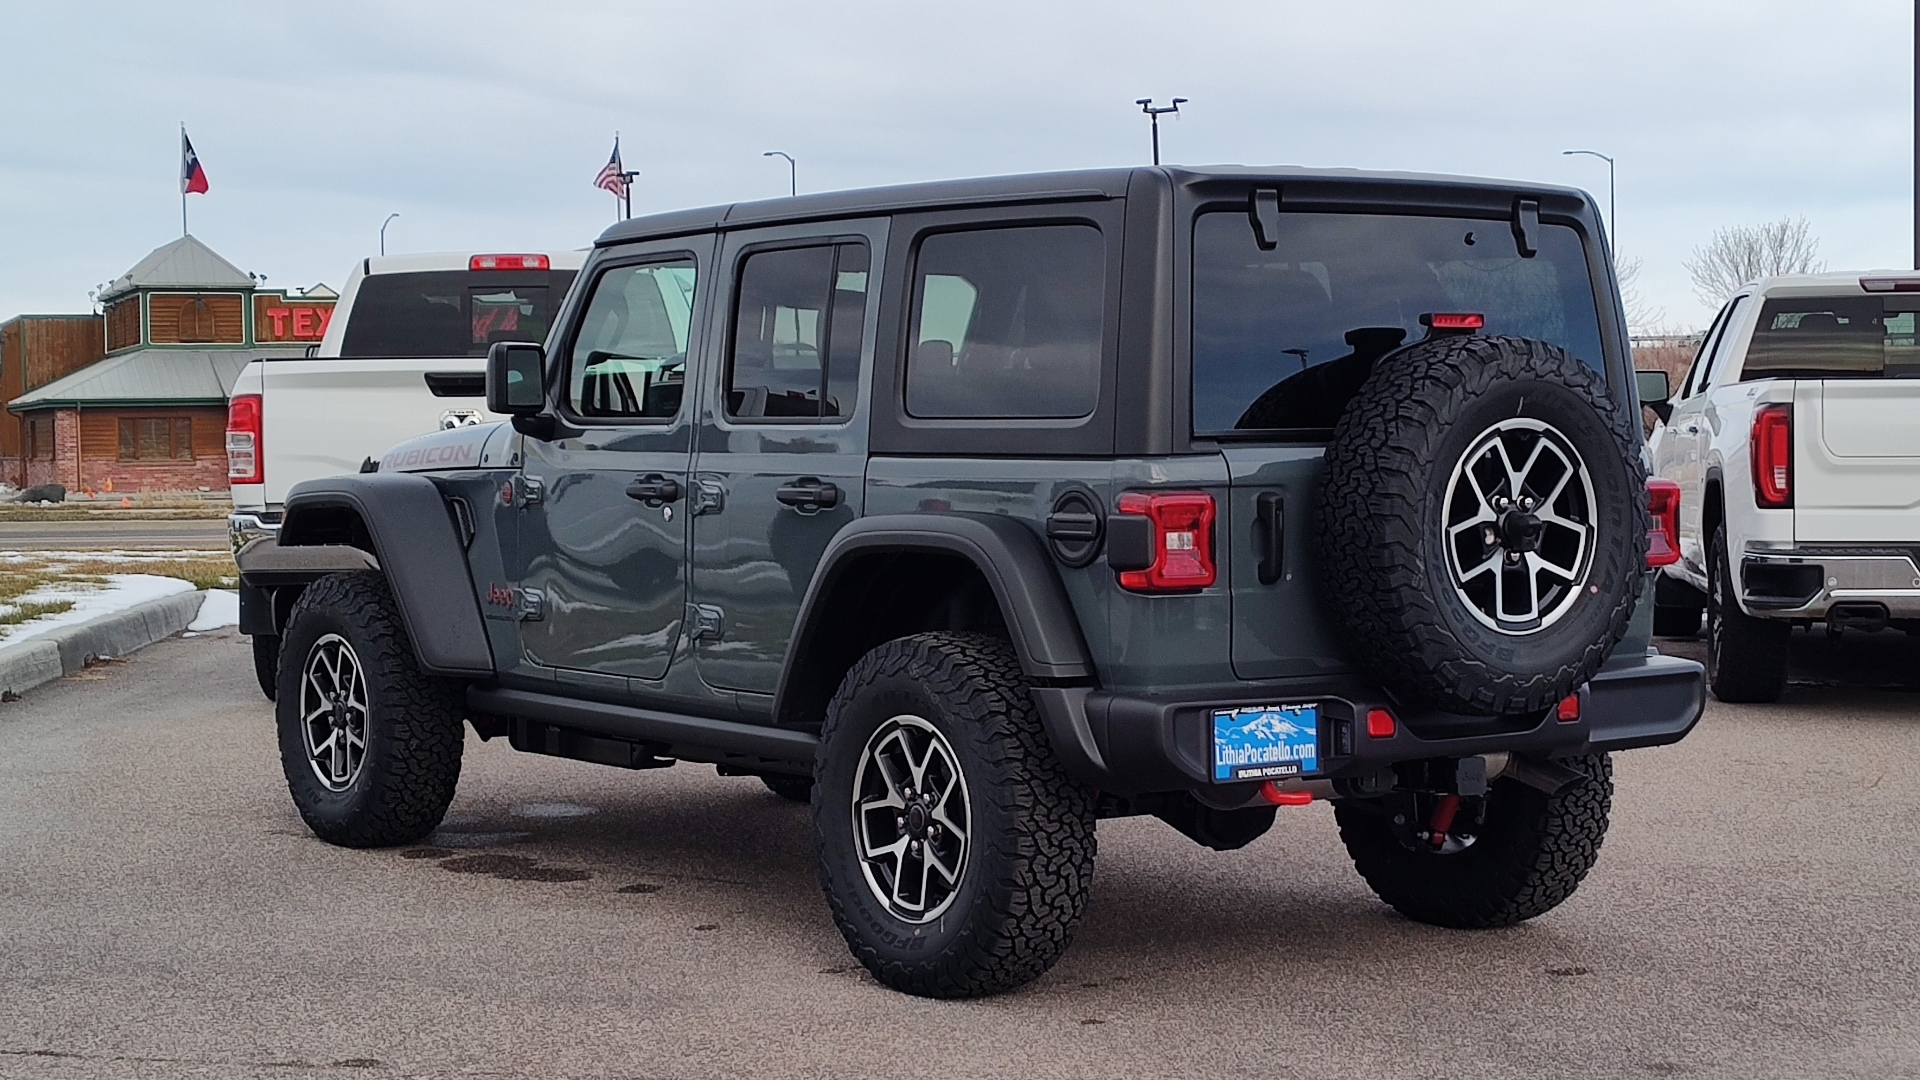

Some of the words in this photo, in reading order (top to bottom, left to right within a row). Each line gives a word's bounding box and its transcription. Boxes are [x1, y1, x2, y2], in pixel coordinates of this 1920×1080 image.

[267, 308, 333, 336] TEX
[380, 444, 474, 469] RUBICON
[487, 583, 514, 610] Jeep
[1216, 741, 1314, 765] LithiaPocatello.com
[1262, 765, 1297, 776] POCATELLO
